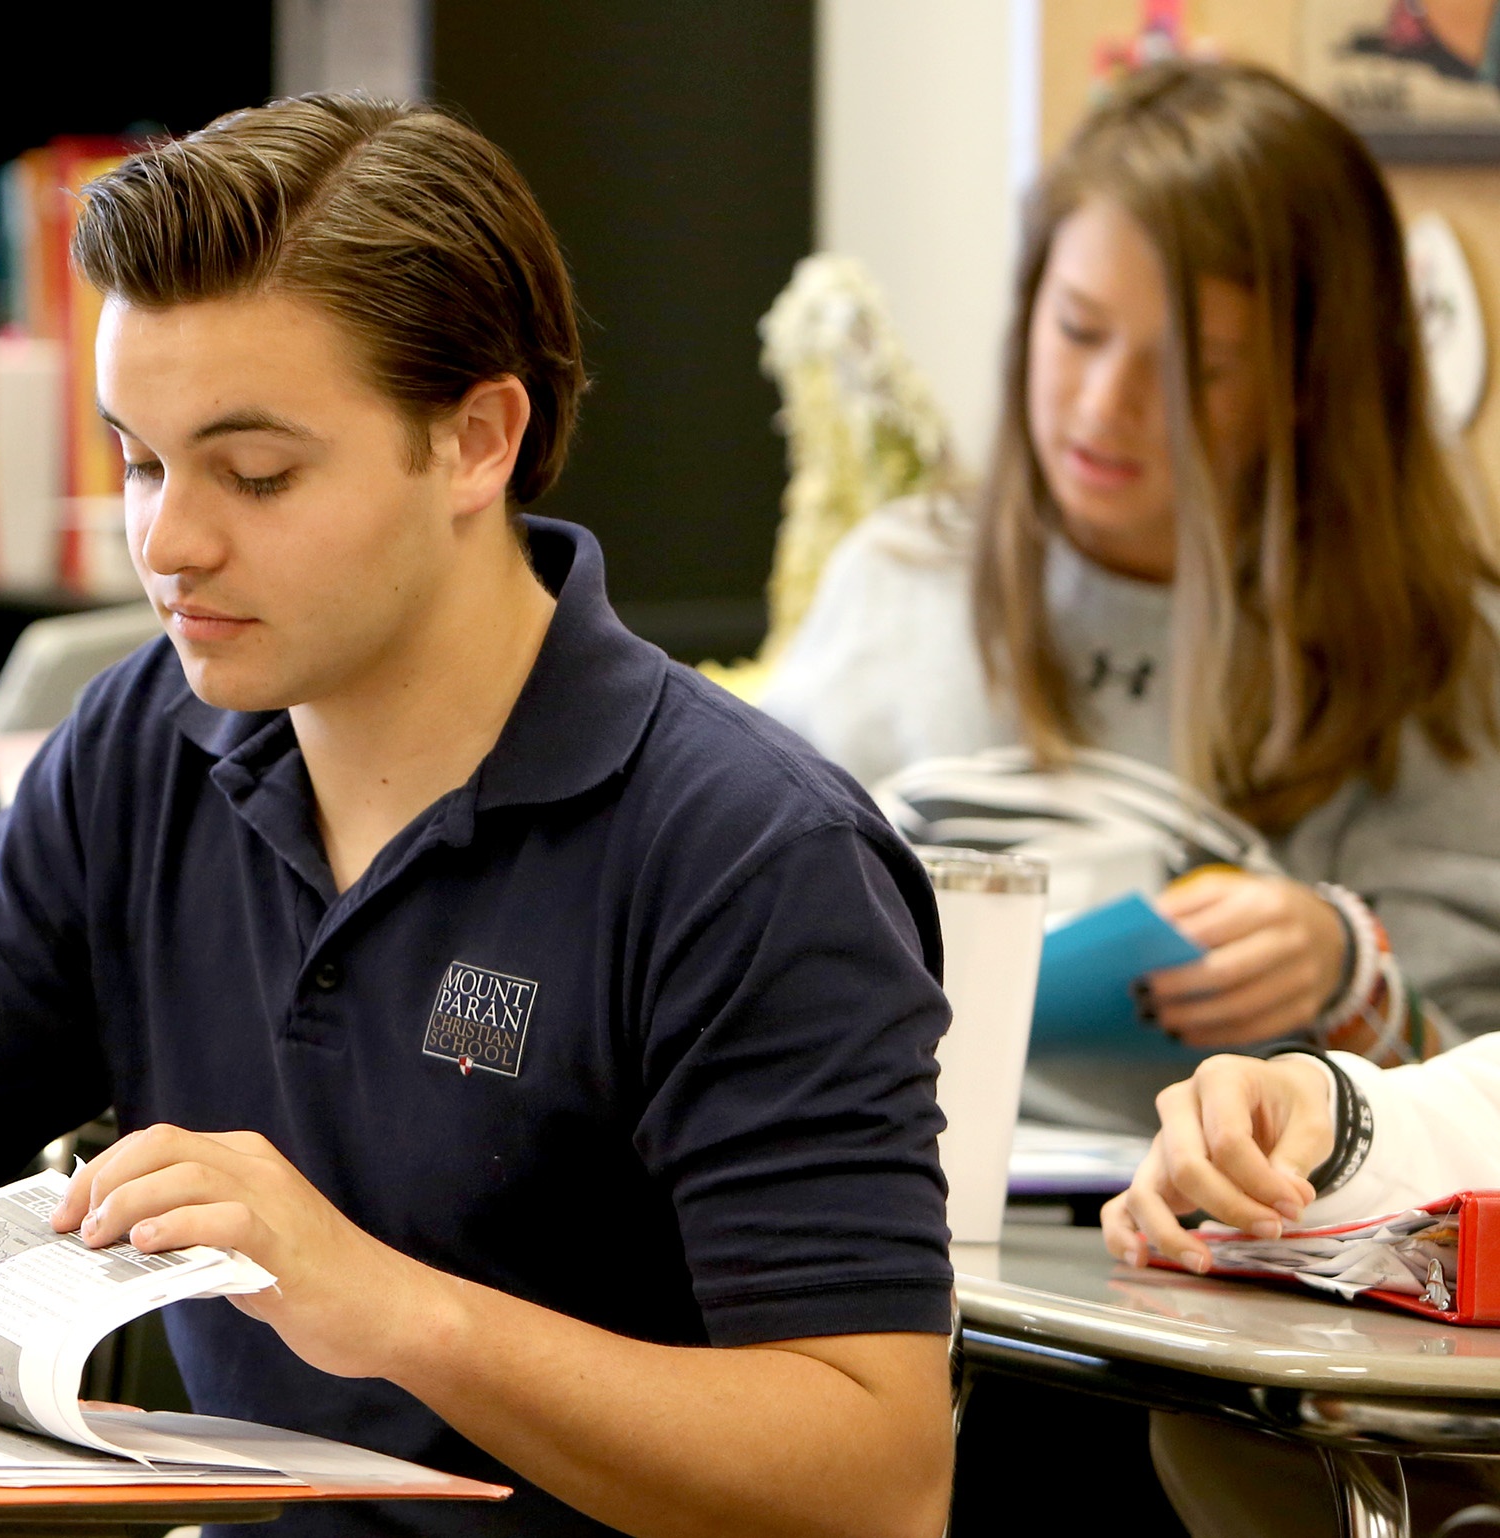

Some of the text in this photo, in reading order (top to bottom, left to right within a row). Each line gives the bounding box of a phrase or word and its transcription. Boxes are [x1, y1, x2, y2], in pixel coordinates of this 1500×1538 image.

[442, 965, 530, 1008] MOUNT
[432, 1013, 518, 1050] CHRISTIAN
[437, 988, 523, 1032] PARAN
[428, 1030, 513, 1066] SCHOOL
[1333, 1136, 1371, 1190] HOPE
